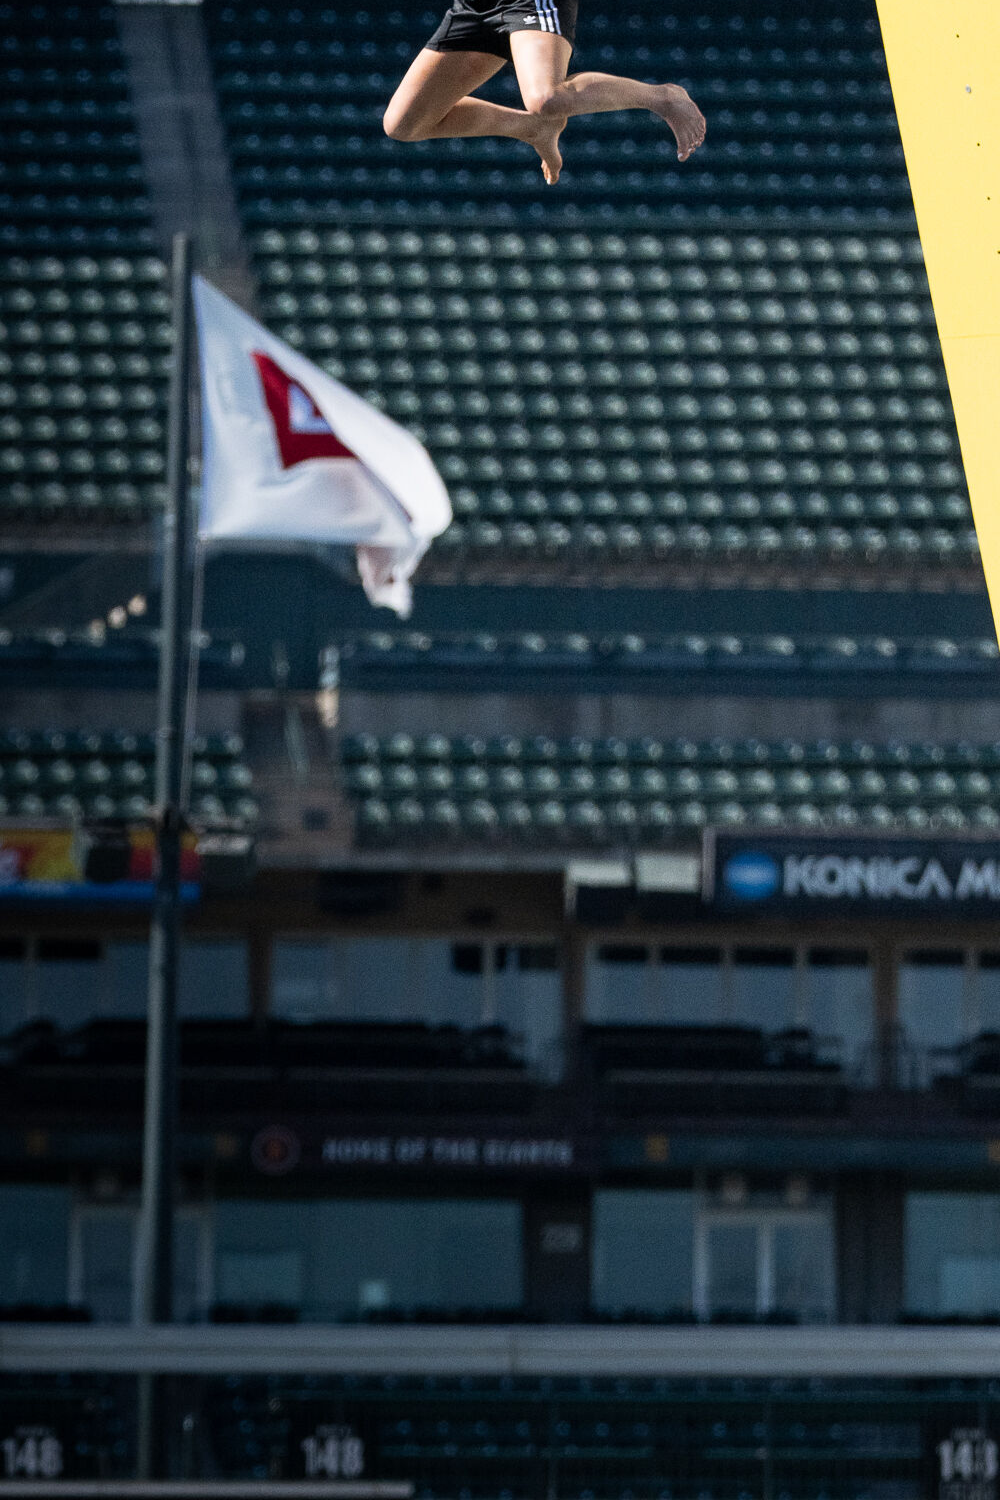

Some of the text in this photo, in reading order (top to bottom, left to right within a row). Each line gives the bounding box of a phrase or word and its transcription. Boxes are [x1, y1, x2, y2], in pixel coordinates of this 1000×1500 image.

[784, 855, 953, 898] KONICA
[322, 1137, 391, 1164] HOME
[394, 1138, 426, 1164] OF
[432, 1138, 478, 1165] THE
